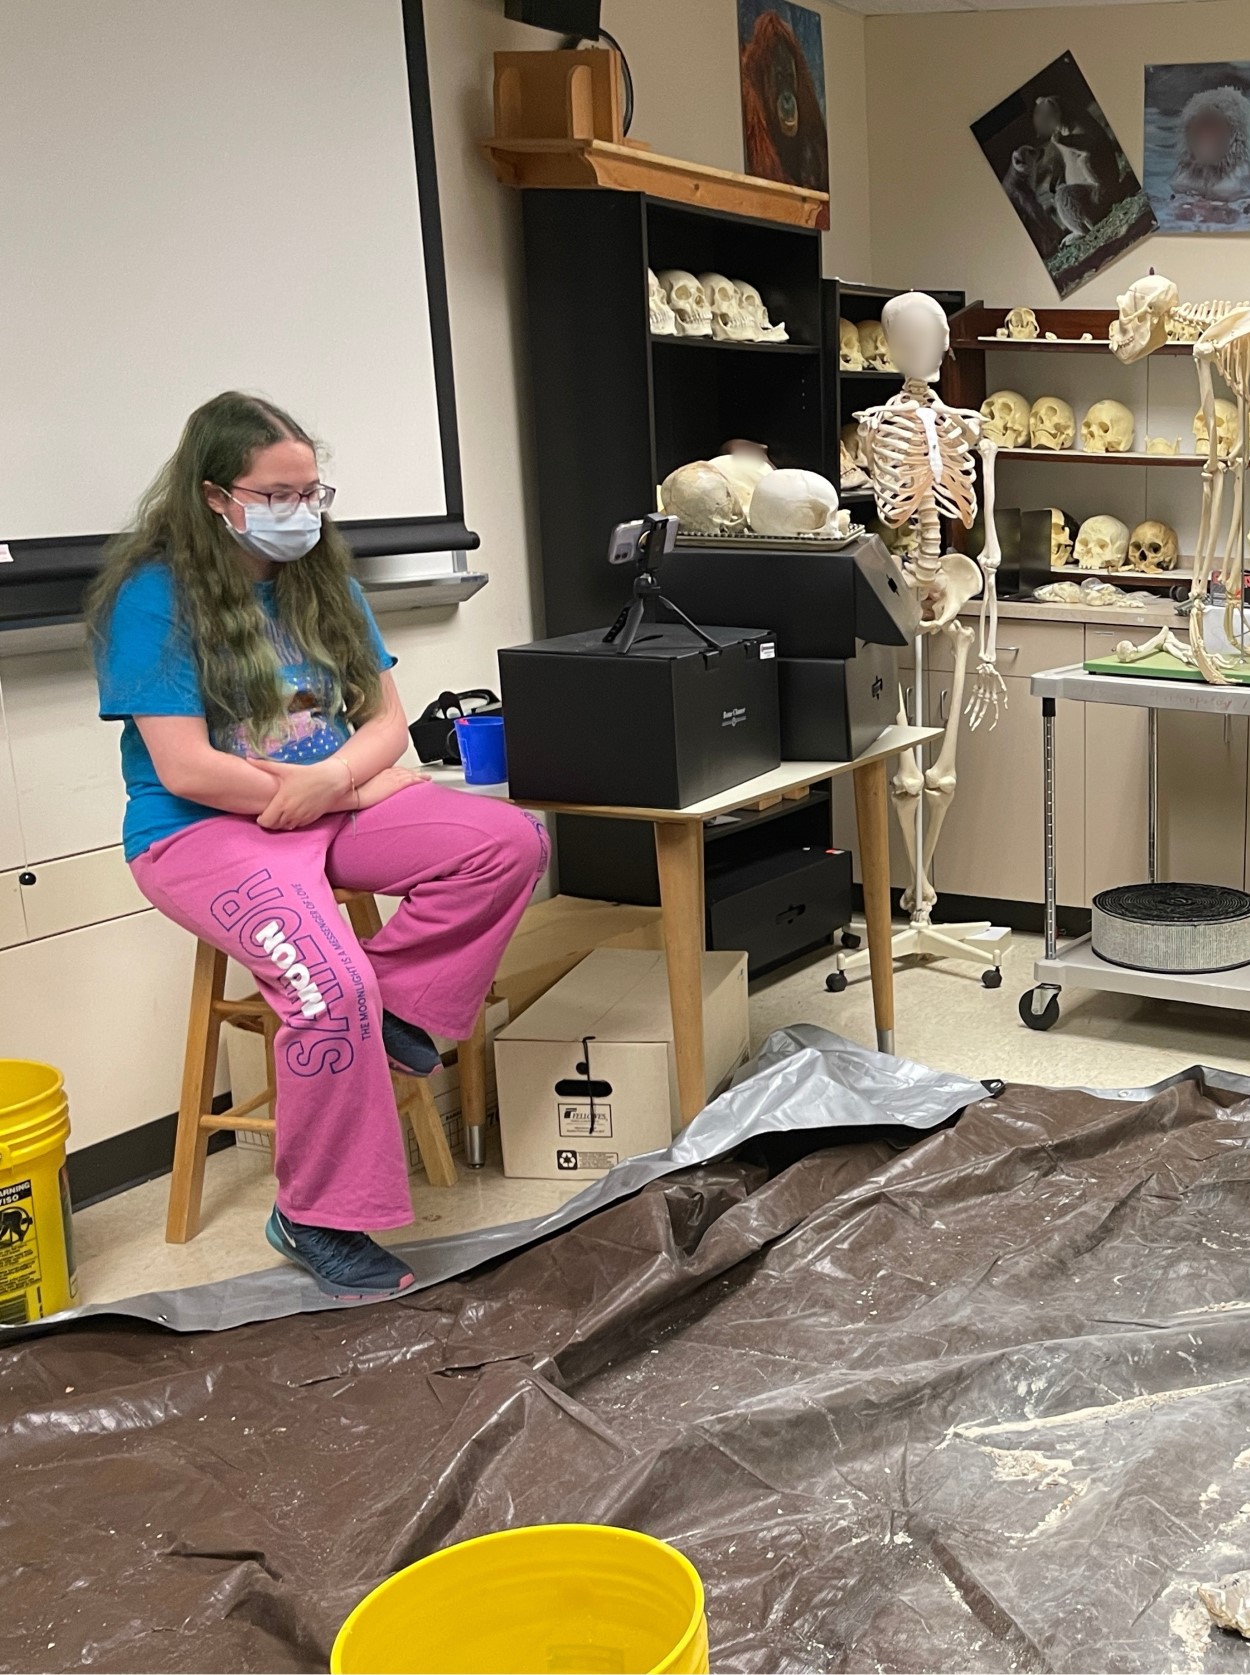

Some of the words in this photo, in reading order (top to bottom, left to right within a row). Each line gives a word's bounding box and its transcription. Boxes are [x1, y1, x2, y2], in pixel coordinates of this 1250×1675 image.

[210, 868, 354, 1078] SAILOR
[255, 920, 327, 1018] MOON
[346, 964, 368, 1022] MOONLIGHT
[361, 1021, 371, 1041] THE
[0, 1194, 19, 1206] ISO
